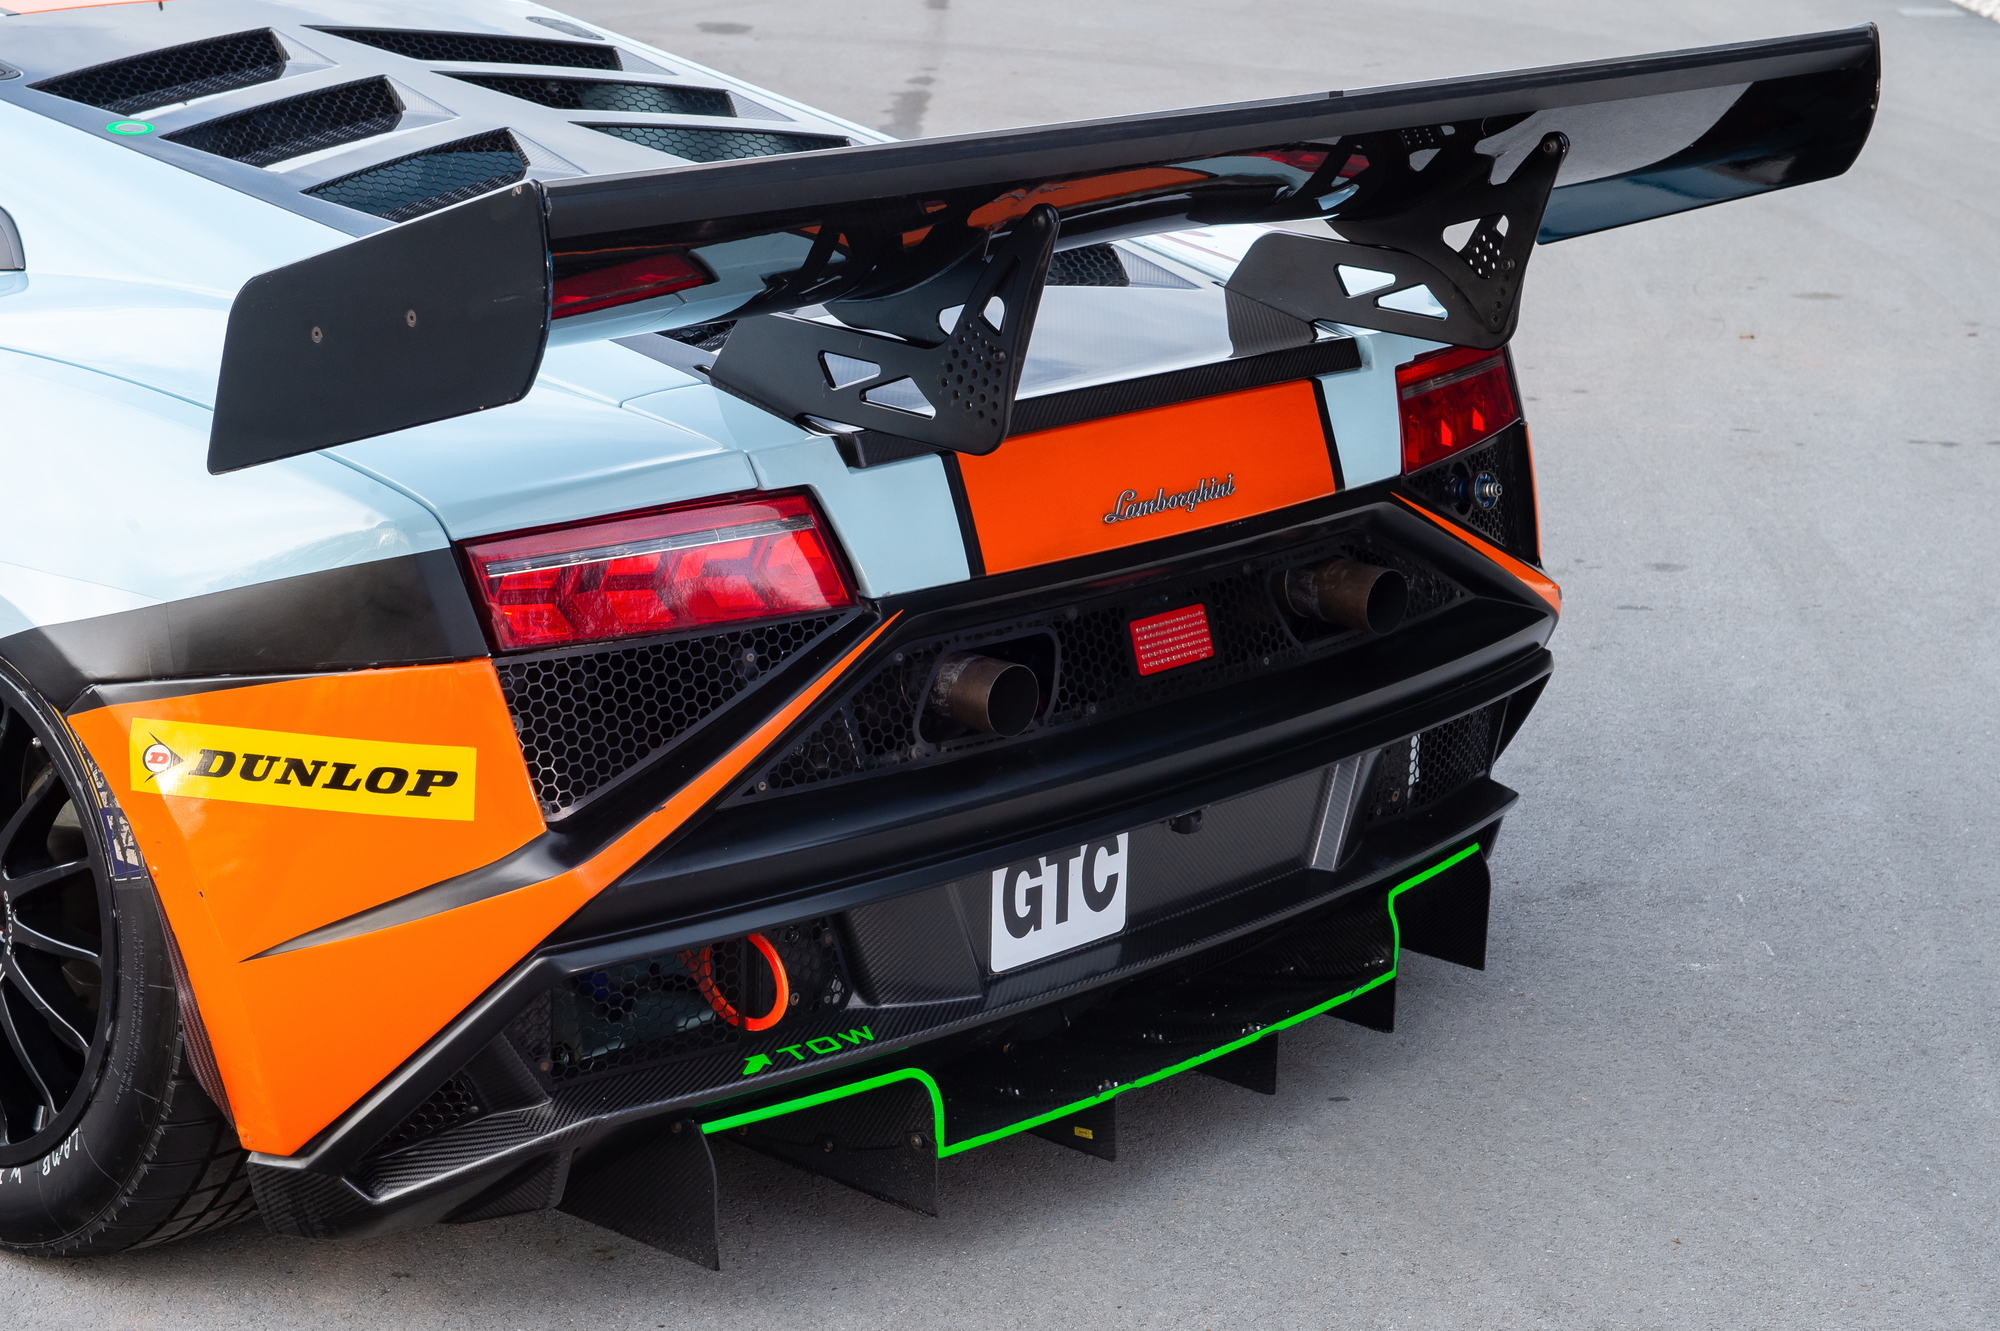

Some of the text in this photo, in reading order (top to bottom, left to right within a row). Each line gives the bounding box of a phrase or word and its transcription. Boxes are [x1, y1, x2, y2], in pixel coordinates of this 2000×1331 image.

[1102, 473, 1236, 524] Lamborghini
[147, 748, 459, 797] D DUNLOP
[1002, 834, 1120, 939] GTC
[3, 890, 13, 956] RACING
[775, 1025, 875, 1061] TOW
[42, 1127, 79, 1176] LAMB
